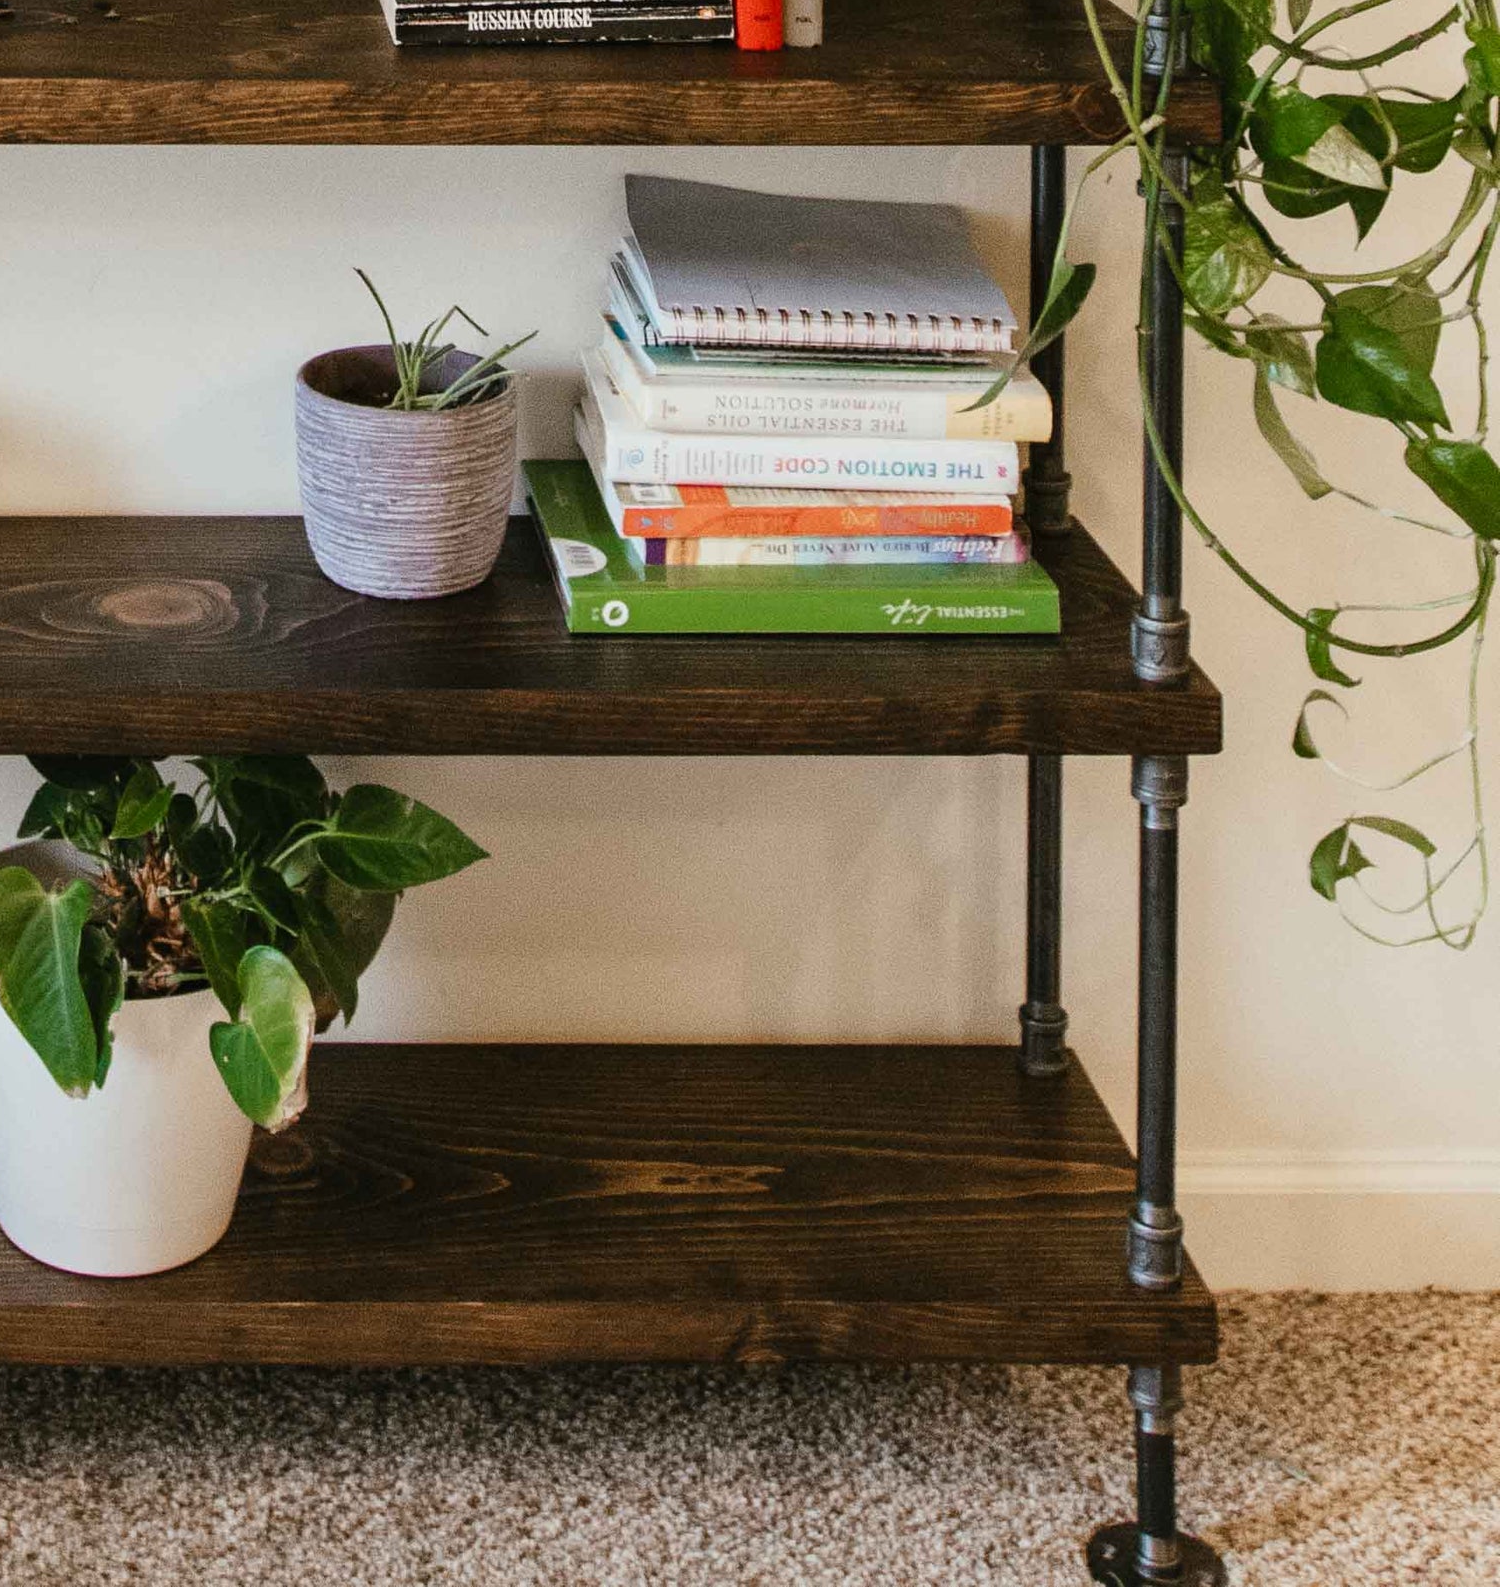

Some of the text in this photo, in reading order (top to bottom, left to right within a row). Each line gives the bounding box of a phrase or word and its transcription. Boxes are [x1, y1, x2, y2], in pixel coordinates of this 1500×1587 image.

[468, 8, 592, 31] RUSSIAN COURSE
[714, 395, 901, 415] Hormone SOLUTION
[707, 414, 908, 433] THE ESSENTIAL OILS
[774, 458, 830, 474] CODE
[838, 459, 937, 477] EMOTION
[946, 463, 985, 479] THE
[935, 605, 1008, 619] ESSENTIAL
